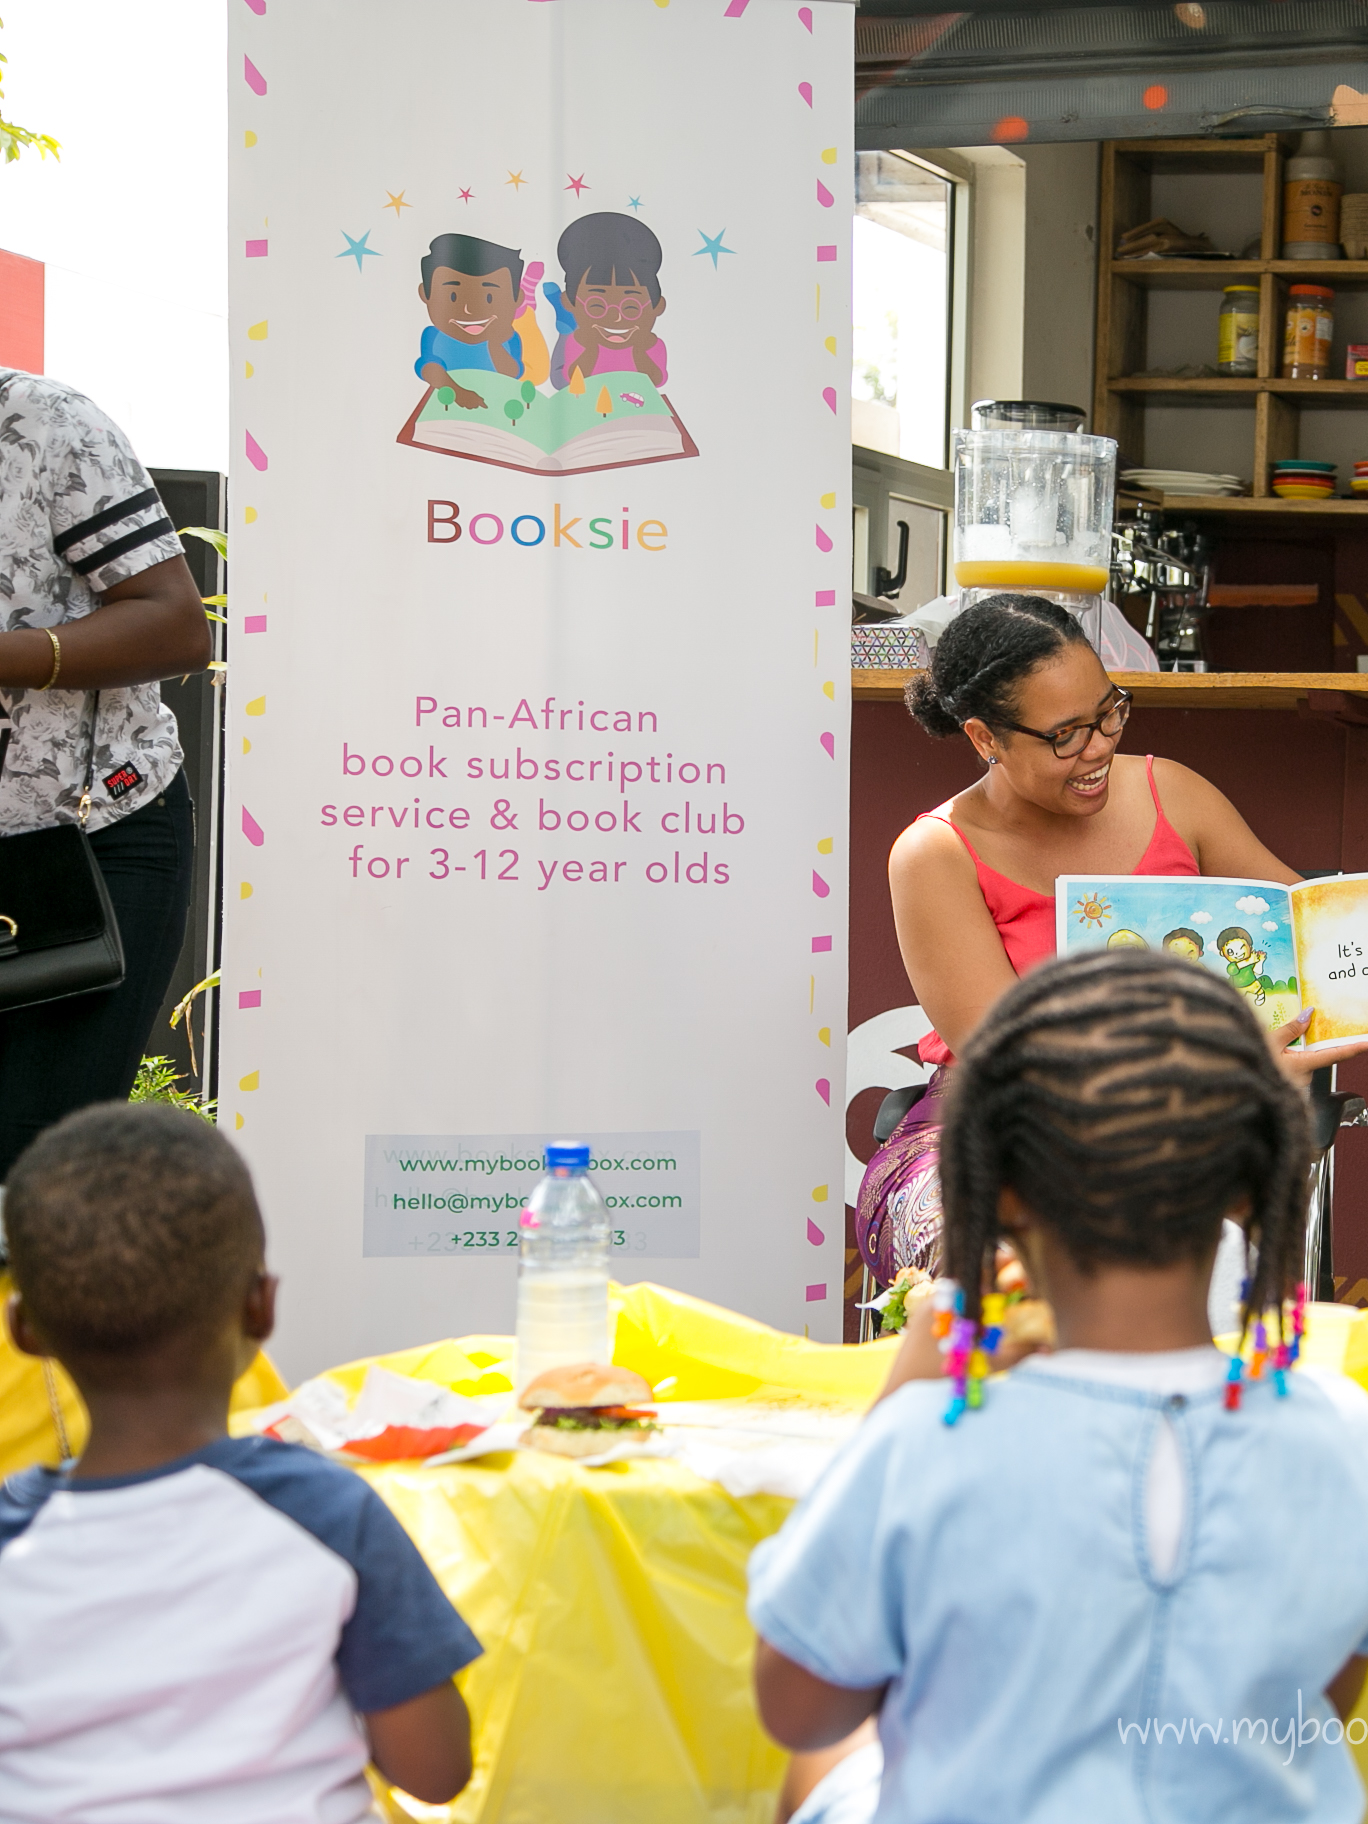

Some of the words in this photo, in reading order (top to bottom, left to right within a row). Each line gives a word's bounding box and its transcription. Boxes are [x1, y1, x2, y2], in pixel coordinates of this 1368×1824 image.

[427, 499, 669, 552] Booksie
[415, 696, 658, 733] Pan-African
[342, 743, 448, 778] book
[466, 746, 727, 792] subscription
[320, 798, 471, 830] service
[489, 799, 519, 831] &
[538, 798, 643, 833] book
[660, 802, 746, 835] club
[348, 845, 410, 879] for
[428, 848, 519, 881] 3-12
[537, 860, 627, 890] year
[645, 851, 730, 885] olds
[1337, 942, 1363, 958] It's
[1328, 963, 1356, 980] and
[450, 1230, 500, 1247] +233
